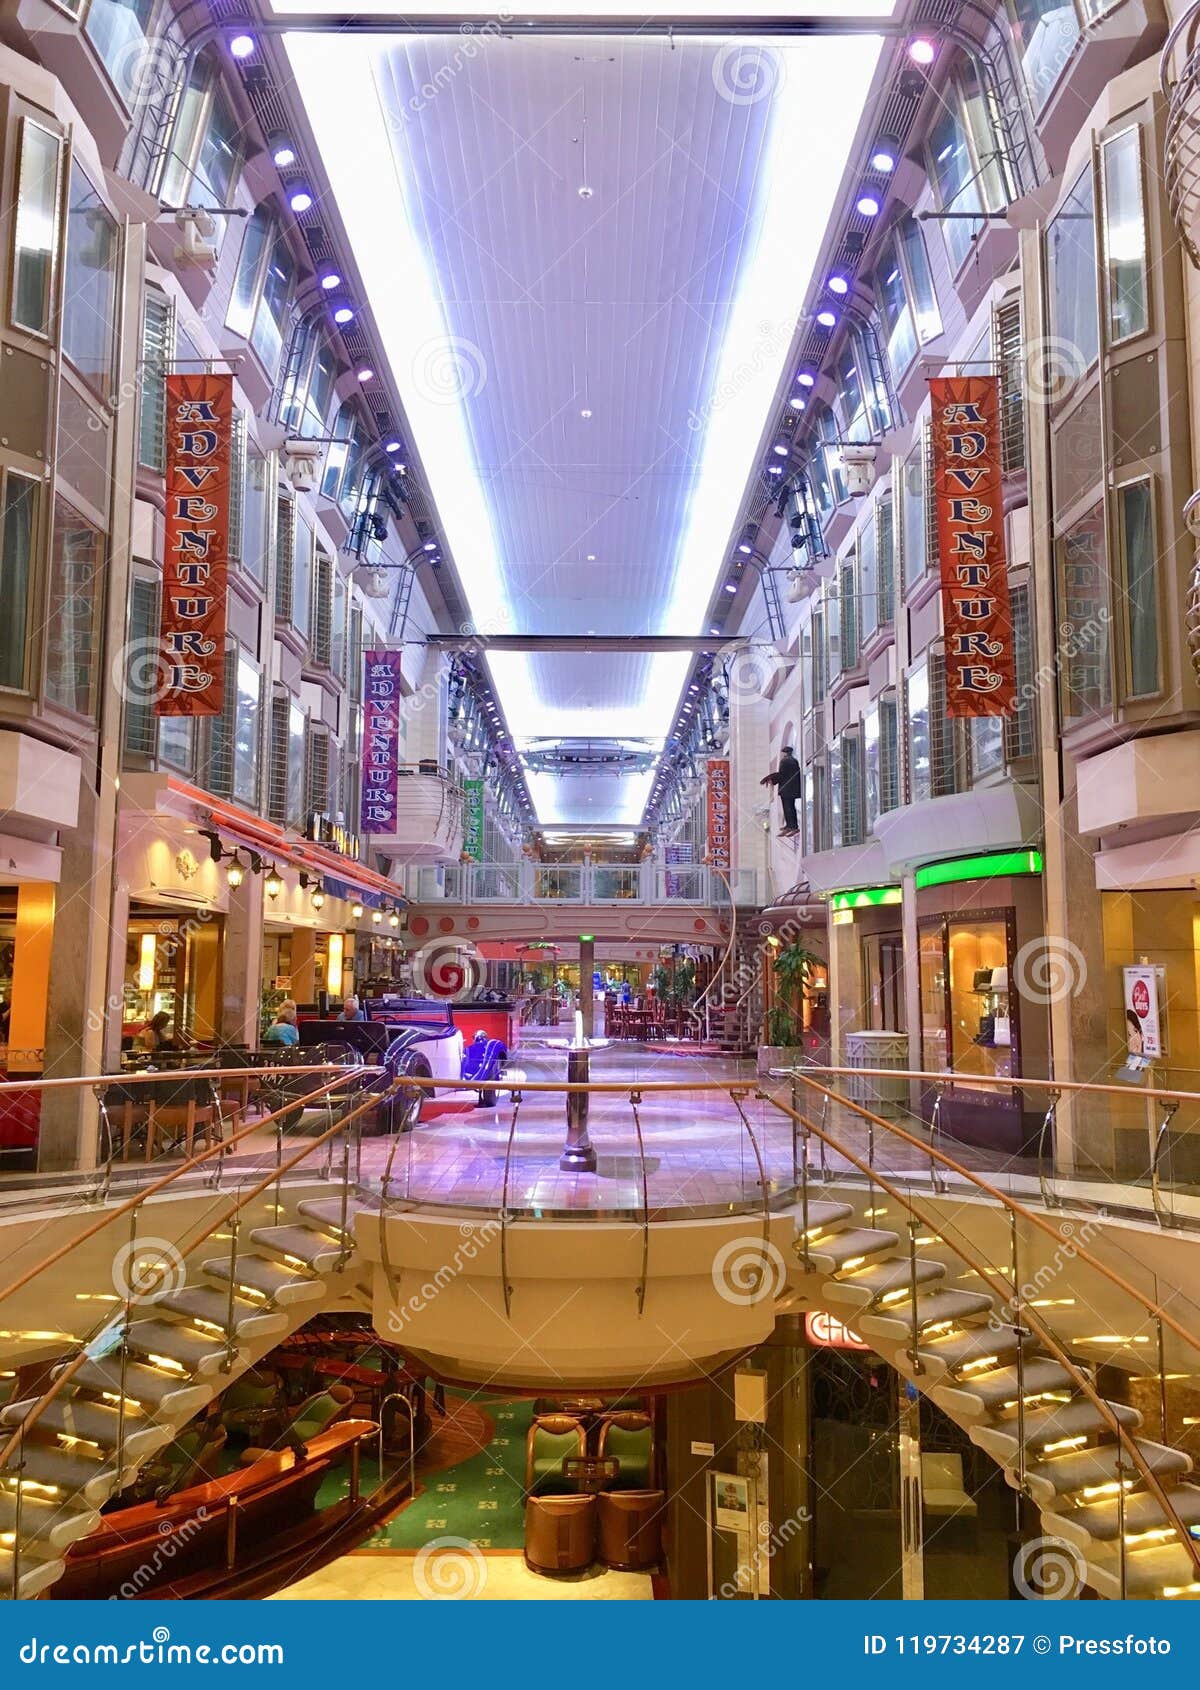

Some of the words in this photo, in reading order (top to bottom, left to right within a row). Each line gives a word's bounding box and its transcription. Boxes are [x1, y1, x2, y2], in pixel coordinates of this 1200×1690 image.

[166, 400, 220, 692] ADVENTURE
[943, 402, 1004, 693] ADVENTURE
[366, 664, 395, 822] ADVENTURE
